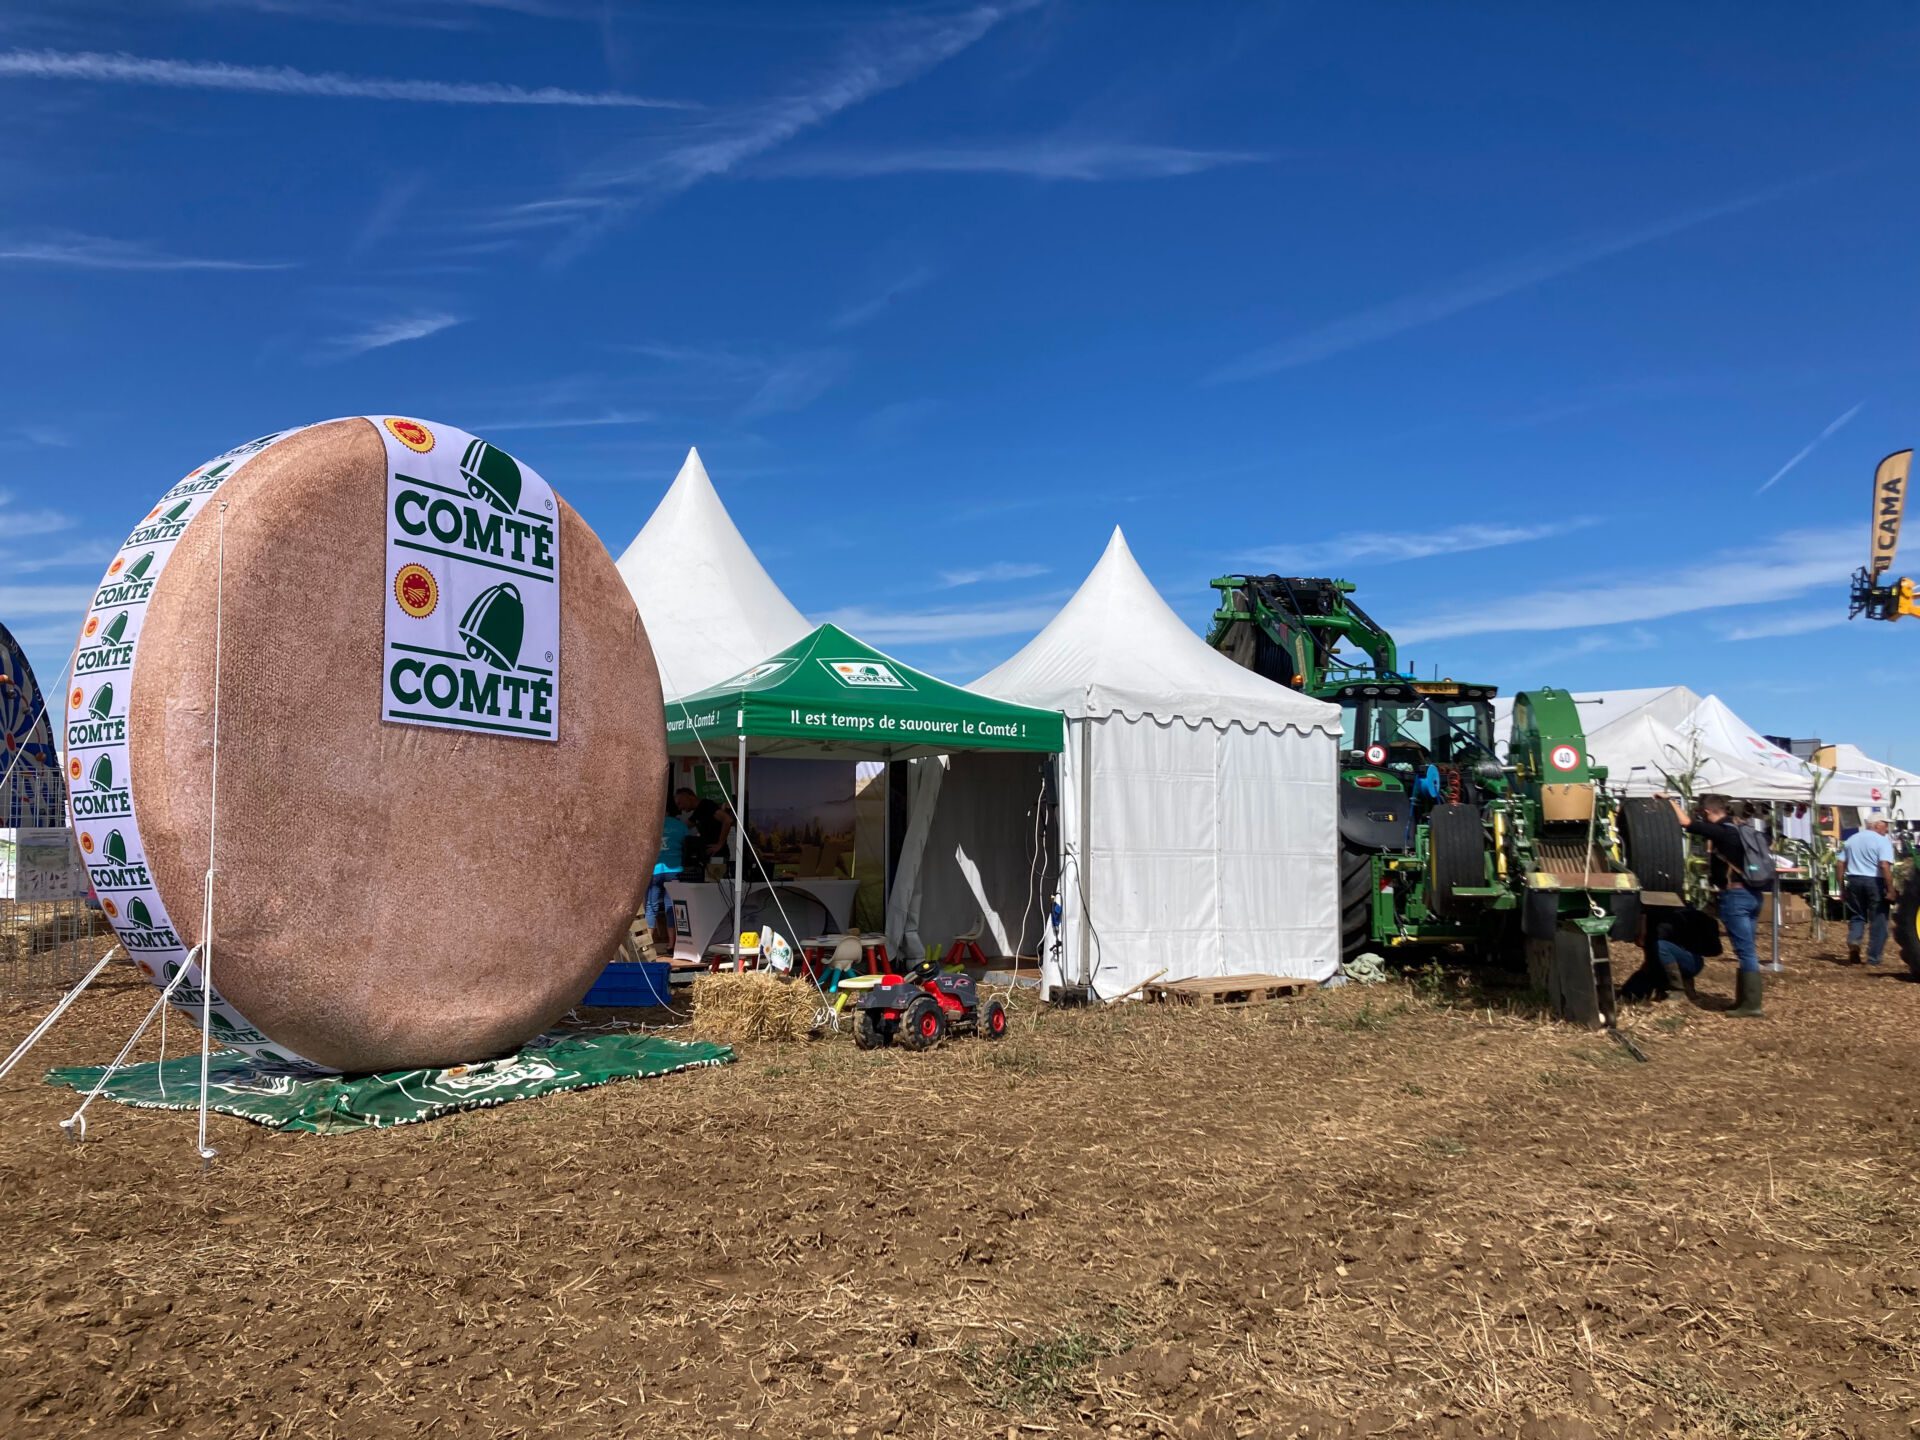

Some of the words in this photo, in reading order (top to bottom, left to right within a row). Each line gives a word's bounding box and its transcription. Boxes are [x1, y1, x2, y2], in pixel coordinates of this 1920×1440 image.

[1878, 477, 1902, 550] CAMA
[394, 489, 554, 570] COMTÉ
[95, 581, 154, 606] COMTÉ
[76, 644, 134, 671] COMTÉ
[389, 657, 553, 724] COMTÉ
[694, 710, 715, 728] Comté
[791, 709, 800, 724] Il
[805, 713, 827, 726] est
[831, 713, 875, 731] temps
[879, 715, 896, 729] de
[900, 719, 959, 733] savourer
[962, 720, 974, 734] le
[978, 721, 1018, 737] Comté
[68, 719, 126, 745] COMTÉ
[1559, 752, 1571, 763] 40
[73, 791, 131, 815] COMTÉ
[91, 865, 150, 887] COMTÉ
[120, 929, 180, 948] COMTÉ
